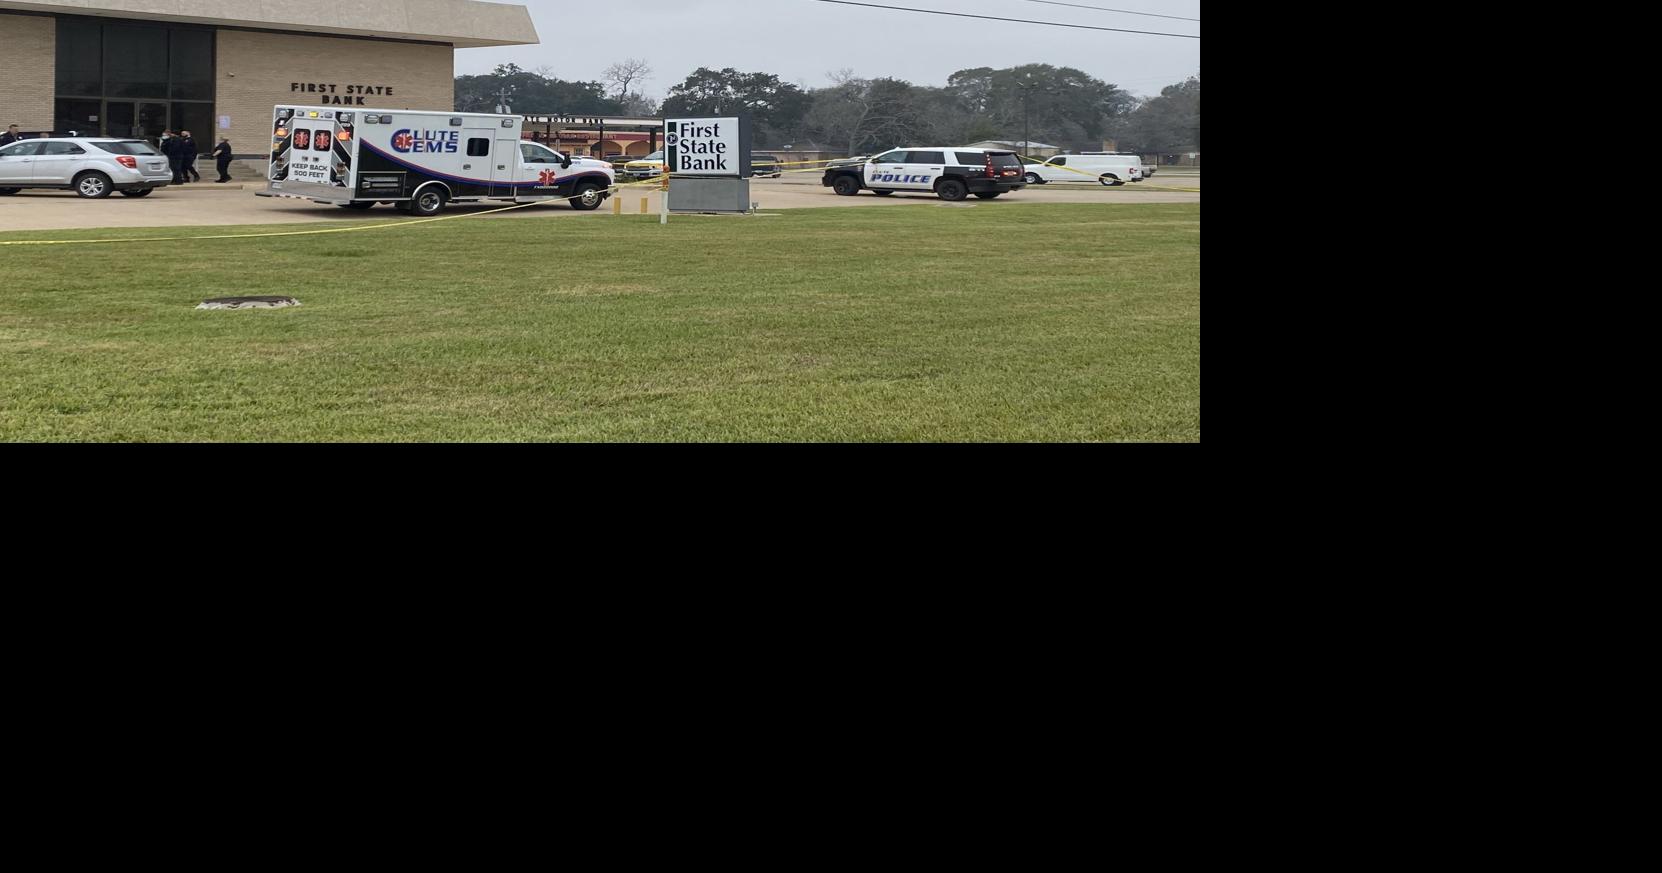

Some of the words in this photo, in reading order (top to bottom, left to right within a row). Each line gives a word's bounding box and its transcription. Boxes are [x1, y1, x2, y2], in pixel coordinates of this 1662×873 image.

[291, 83, 337, 93] FIRST
[346, 85, 393, 96] STATE
[321, 95, 366, 105] BANK
[680, 122, 720, 138] First
[412, 140, 458, 153] EMS
[680, 138, 726, 154] State
[291, 162, 309, 170] KEEP
[309, 164, 329, 172] BACK
[680, 154, 727, 171] Bank
[870, 173, 932, 184] POLICE
